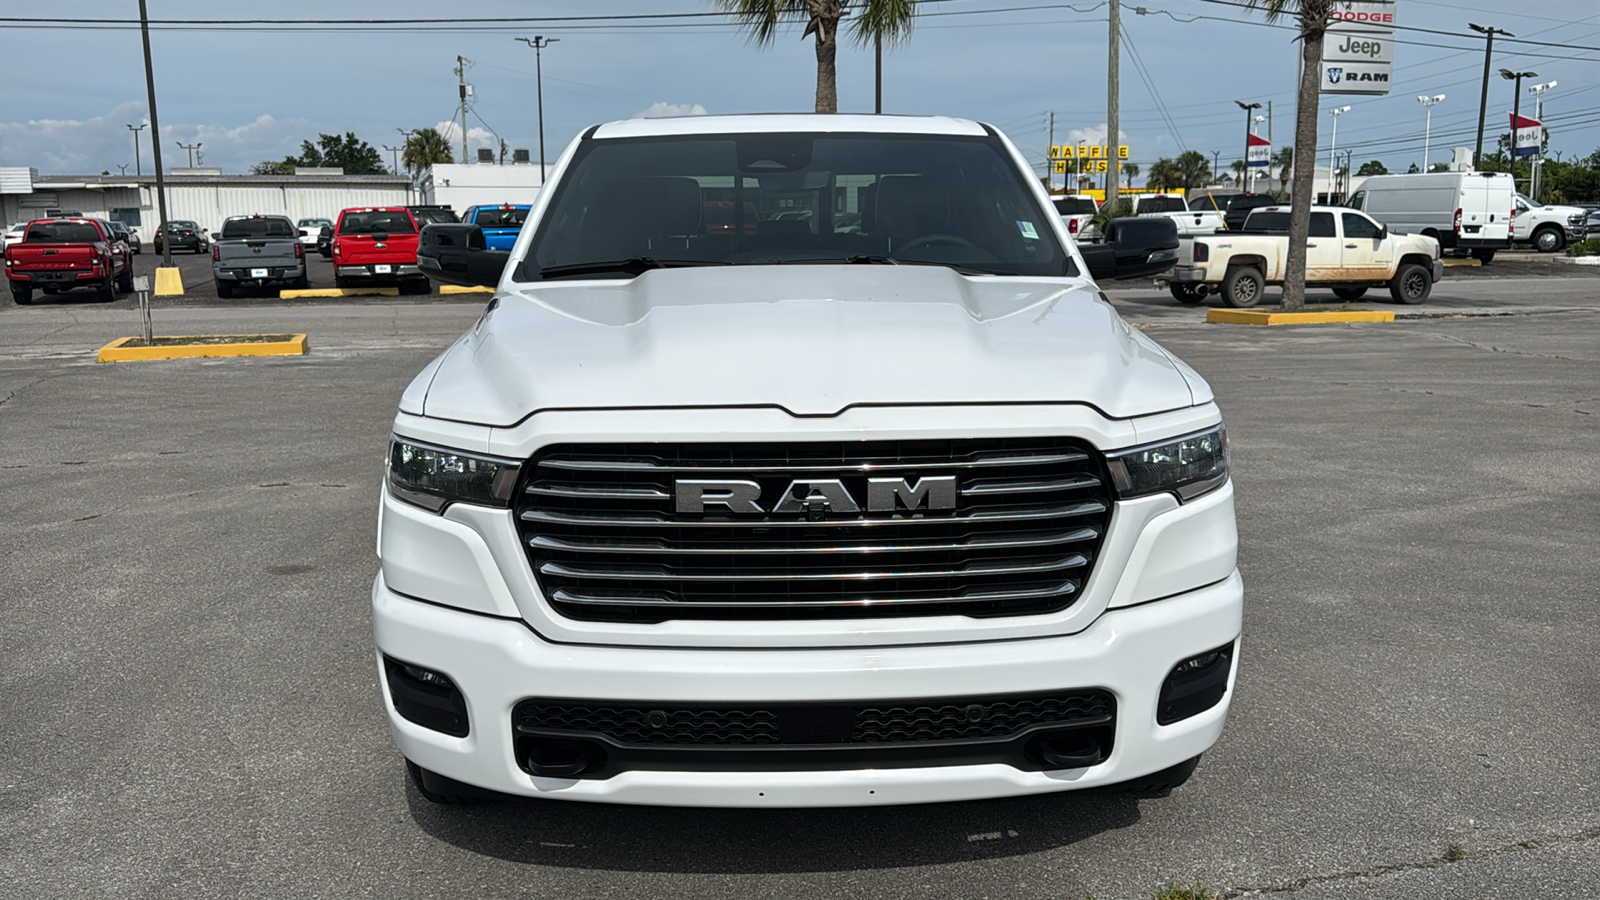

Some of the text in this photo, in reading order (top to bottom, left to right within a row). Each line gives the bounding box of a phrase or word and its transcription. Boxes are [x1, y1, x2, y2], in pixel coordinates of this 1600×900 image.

[1330, 11, 1393, 23] DODGE
[1338, 36, 1382, 58] Jeep
[1345, 72, 1389, 82] RAM
[1050, 147, 1127, 157] WAFFE
[675, 475, 957, 513] RAM
